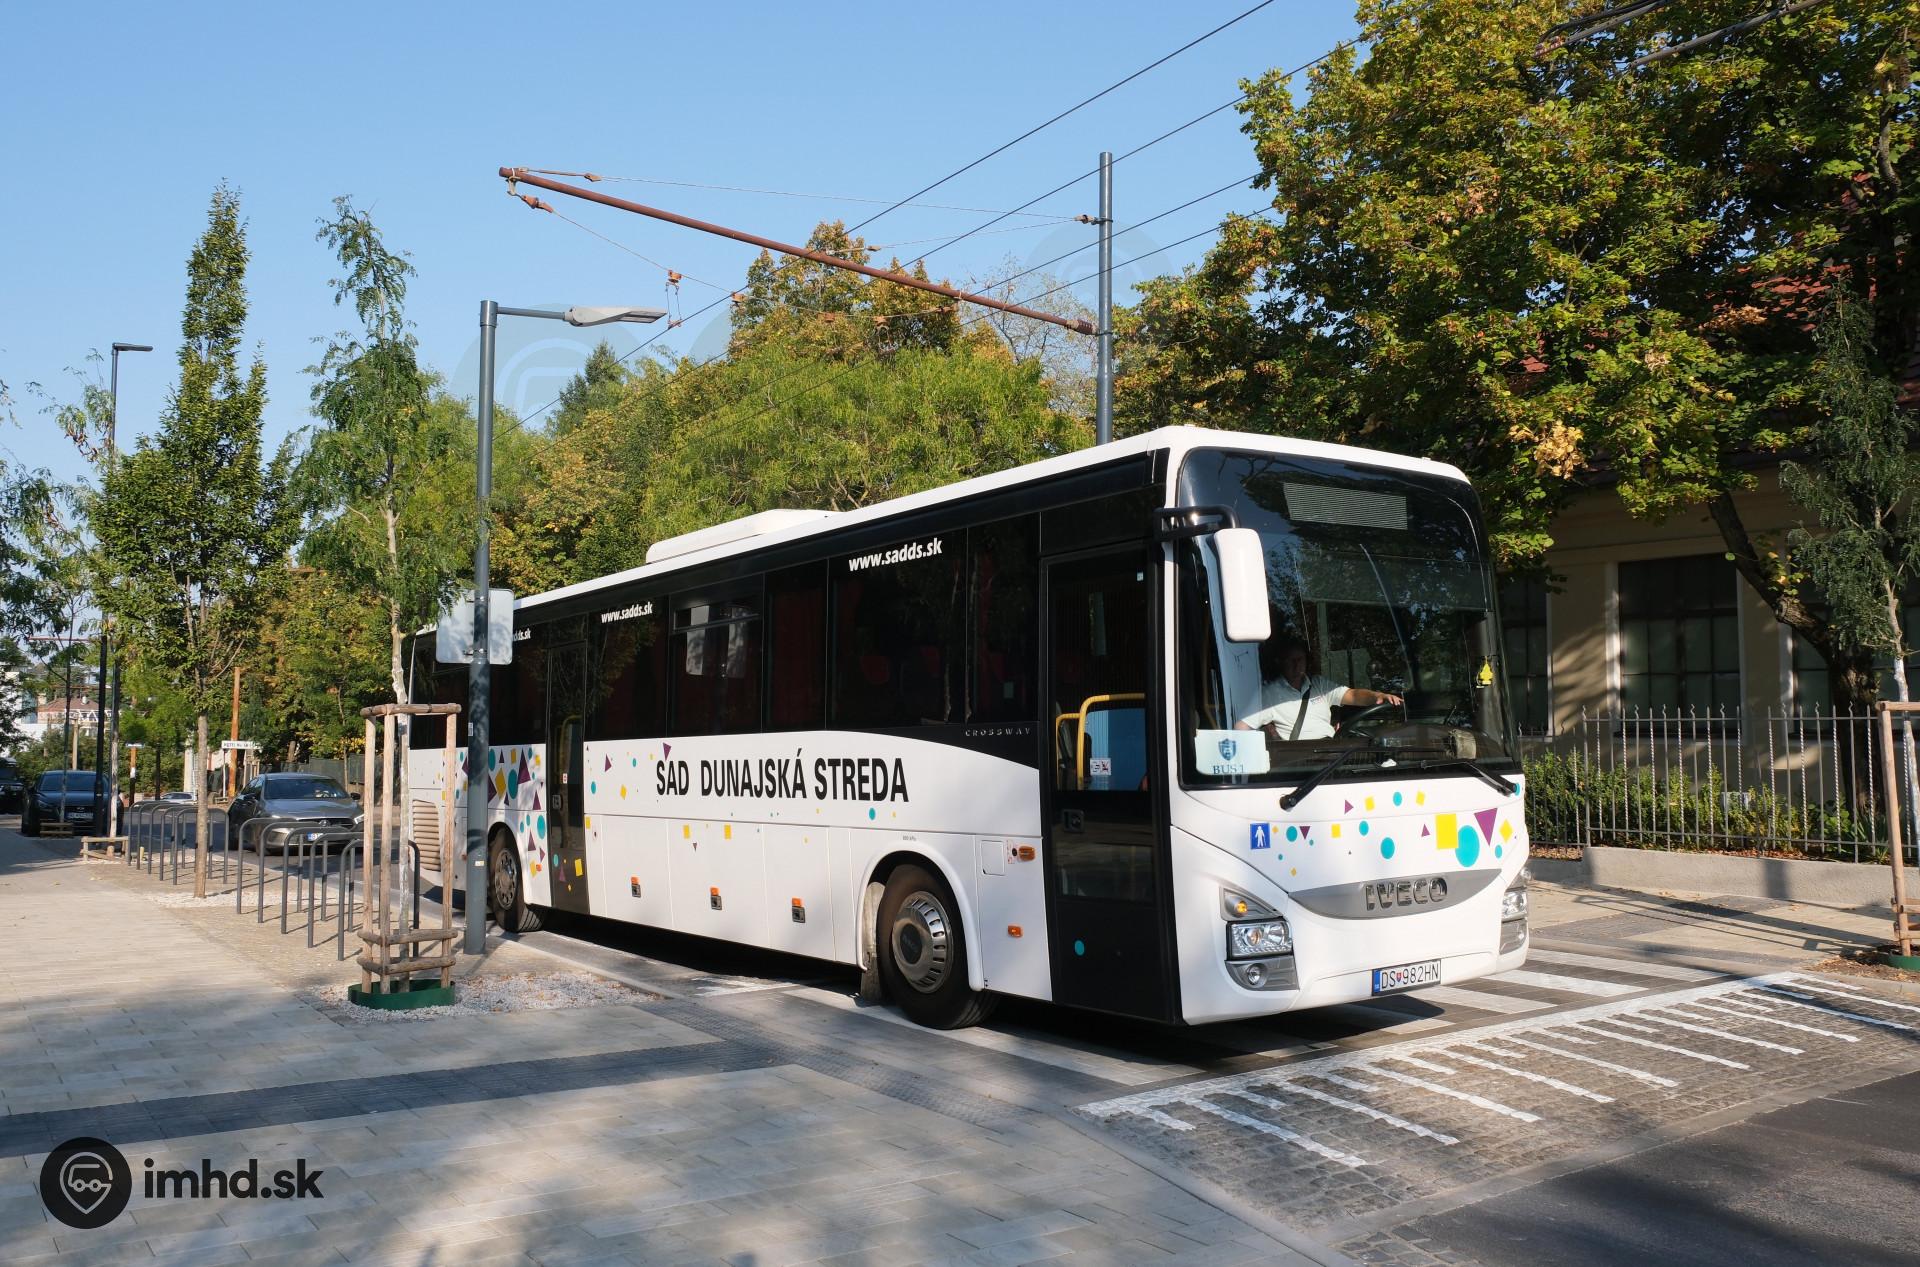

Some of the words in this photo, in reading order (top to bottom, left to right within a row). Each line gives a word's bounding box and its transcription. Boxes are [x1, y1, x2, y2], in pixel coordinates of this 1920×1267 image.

[849, 537, 942, 571] www.sadds.sk
[601, 601, 653, 623] www.sadds.sk
[965, 727, 1030, 736] CROSSWAY
[656, 760, 690, 796] SAD
[701, 747, 807, 799] DUNAJSKÁ
[814, 757, 909, 802] STREDA
[1213, 764, 1237, 775] BUS
[1366, 877, 1448, 911] IVECO
